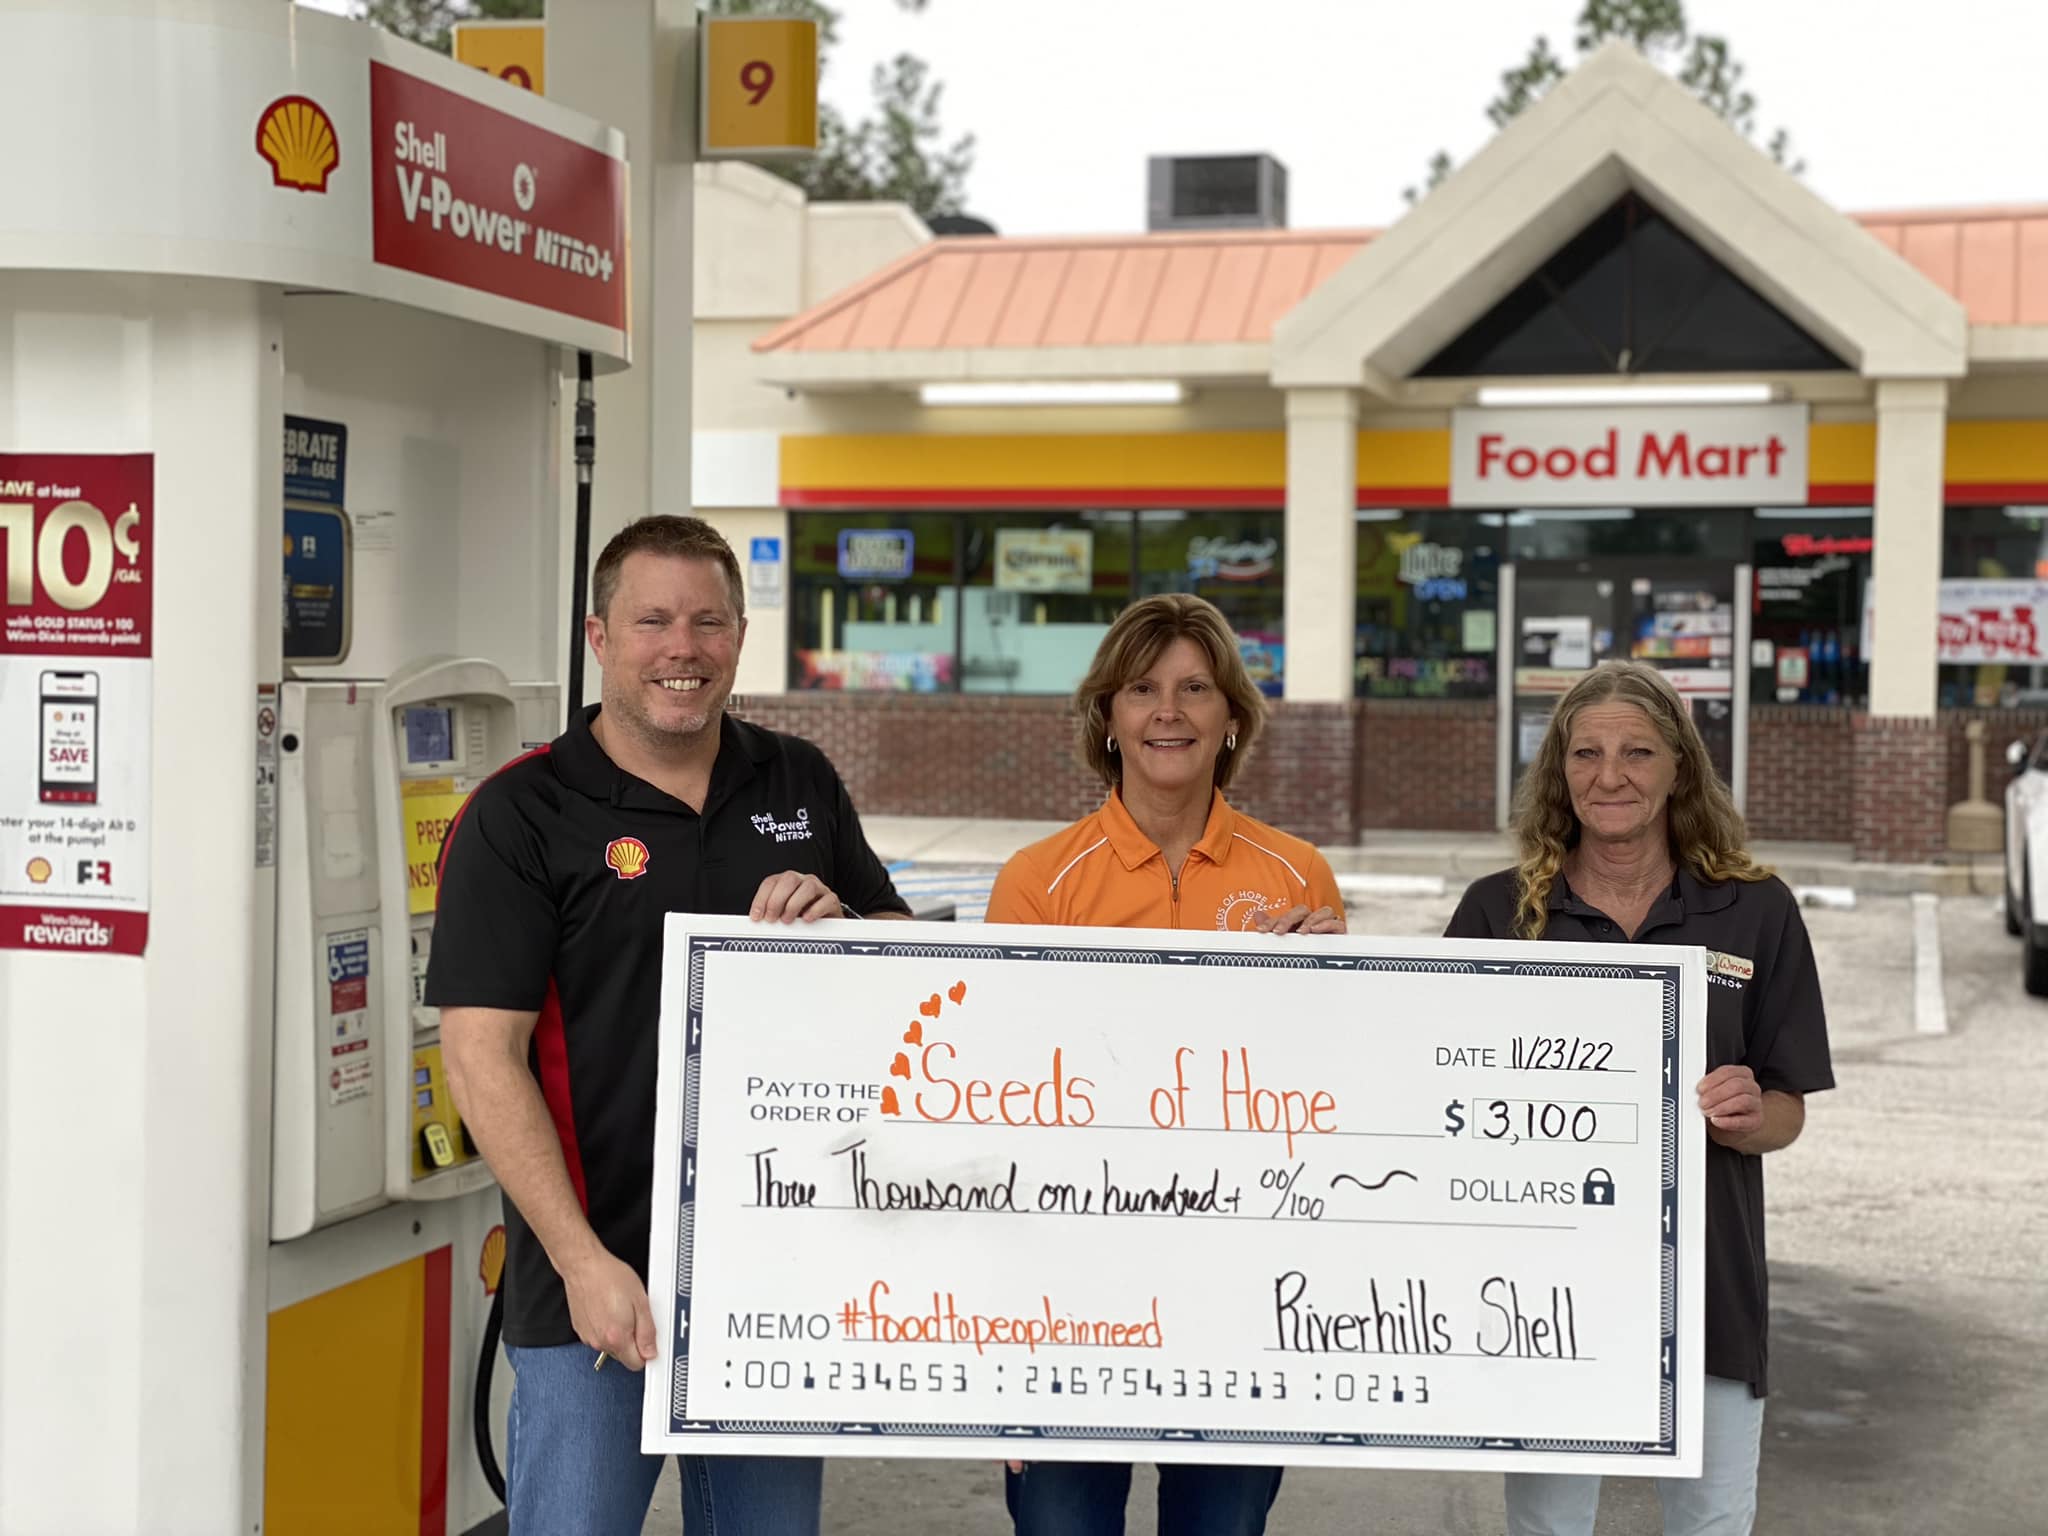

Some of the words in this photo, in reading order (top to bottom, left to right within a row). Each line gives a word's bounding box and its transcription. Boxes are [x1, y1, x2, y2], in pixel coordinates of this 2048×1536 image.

[740, 60, 775, 106] 9
[395, 121, 447, 173] Shell
[396, 164, 526, 255] V-Power
[1477, 427, 1618, 479] Food
[1635, 431, 1787, 478] Mart
[49, 747, 89, 764] SAVE
[28, 819, 55, 831] your
[751, 812, 774, 824] Shell
[754, 821, 810, 835] V-Power
[45, 832, 63, 843] the
[1223, 893, 1235, 906] OF
[1239, 890, 1268, 905] HOPE
[24, 921, 109, 946] rewards
[1720, 957, 1752, 976] Winnie
[1435, 1047, 1497, 1067] DATE
[1511, 1036, 1614, 1071] 11/23/22
[747, 1077, 795, 1098] PAY
[801, 1082, 830, 1099] TO
[835, 1083, 880, 1100] THE
[915, 1042, 1096, 1127] Seeds
[1150, 1047, 1194, 1129] of
[1222, 1047, 1338, 1159] Hope
[750, 1104, 831, 1122] ORDER
[836, 1107, 870, 1123] OF
[1444, 1099, 1466, 1137] $
[1483, 1100, 1597, 1145] 3,100
[831, 1139, 1029, 1212] Thousand
[1450, 1178, 1576, 1204] DOLLARS
[727, 1313, 831, 1340] MEMO
[836, 1280, 1163, 1355] #foodtopeopleinneed
[1275, 1271, 1452, 1354] Riverhills
[1477, 1277, 1577, 1360] Shell
